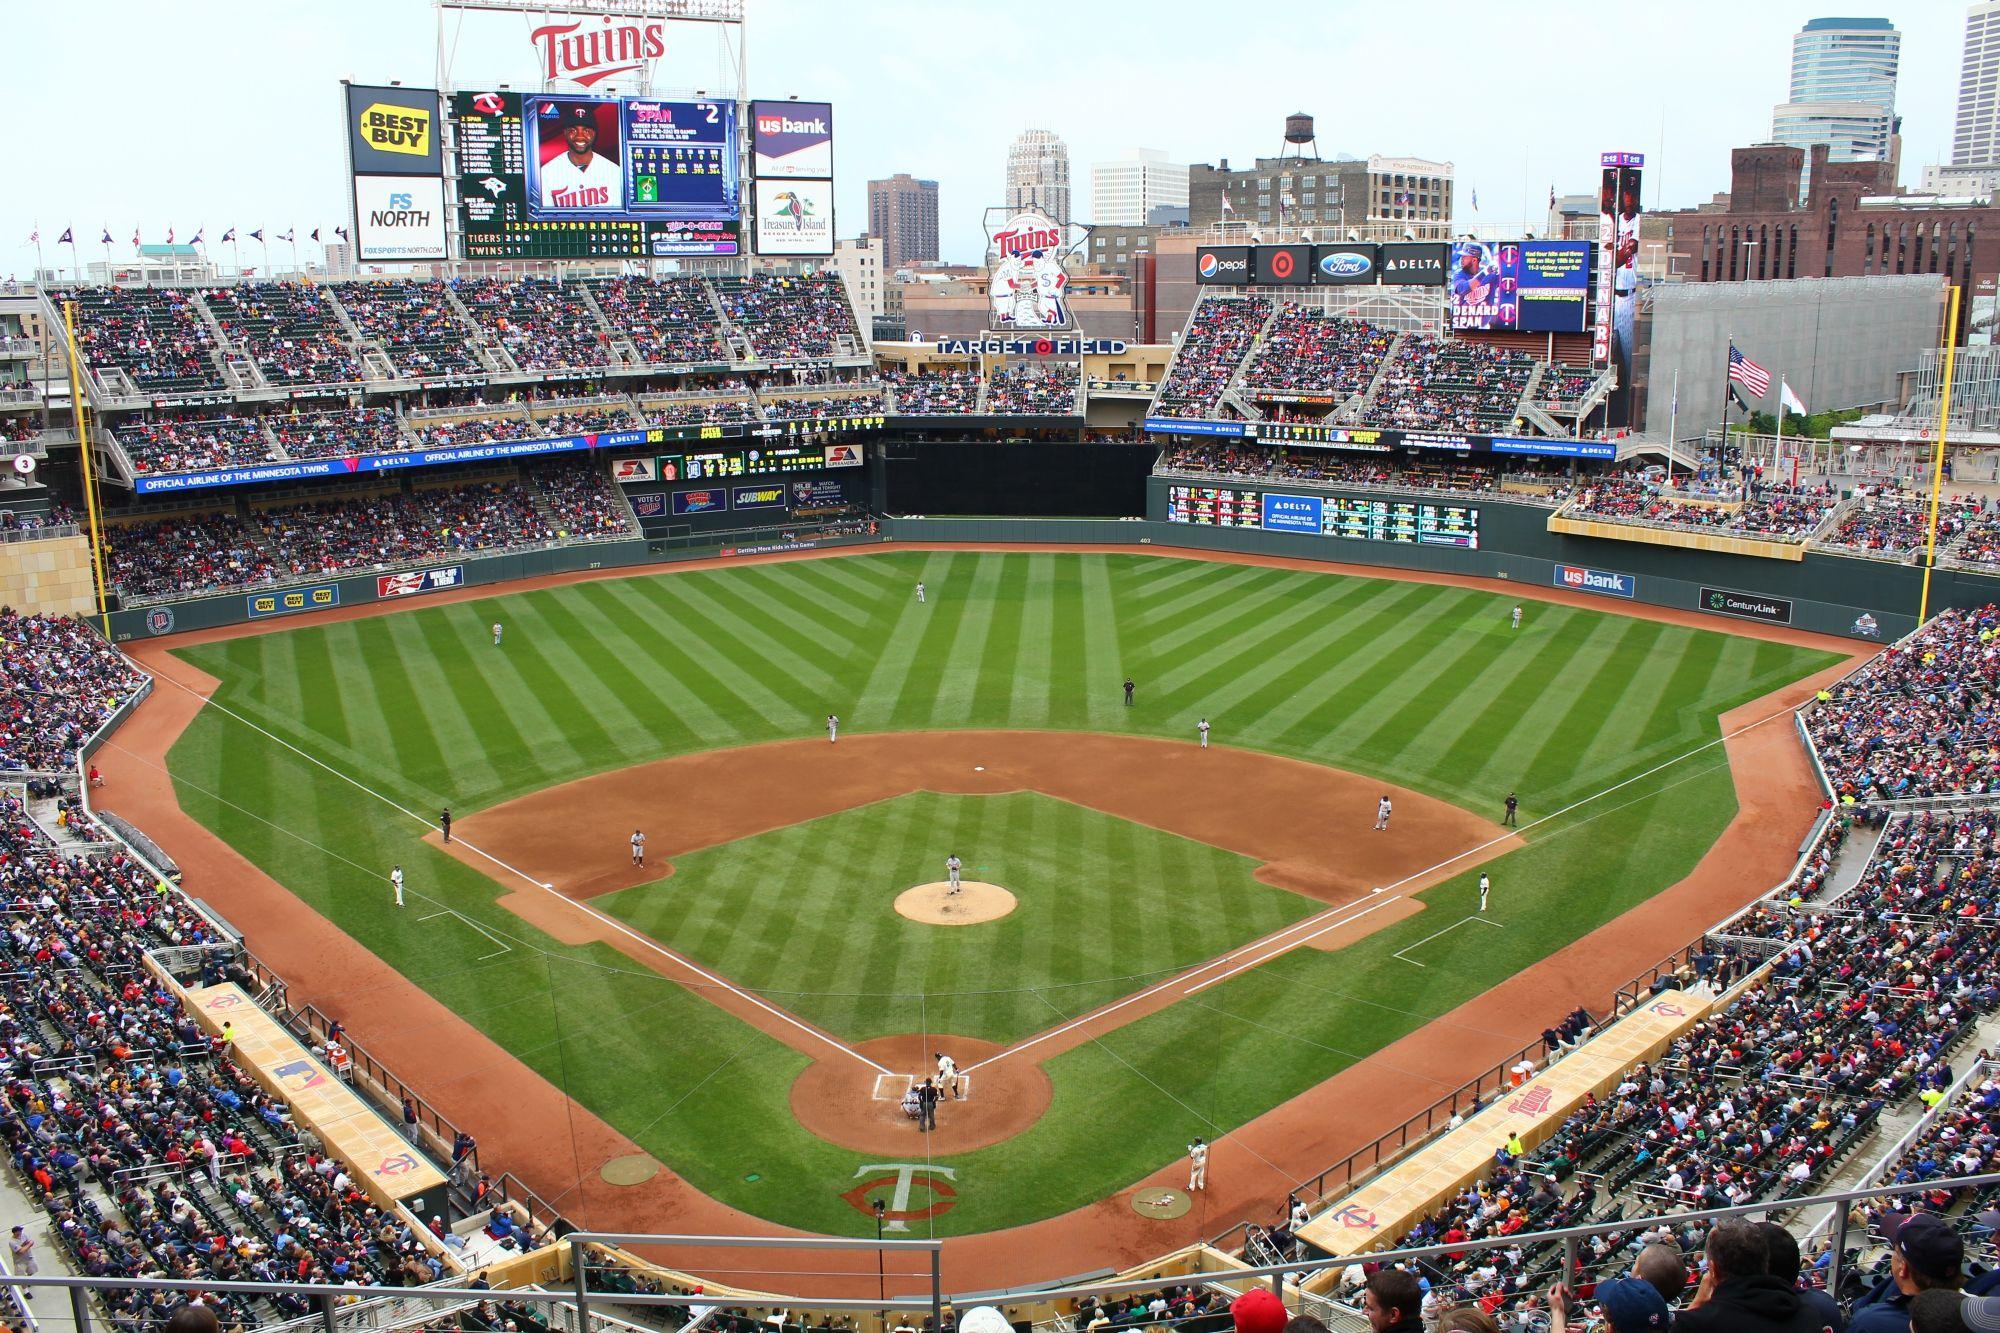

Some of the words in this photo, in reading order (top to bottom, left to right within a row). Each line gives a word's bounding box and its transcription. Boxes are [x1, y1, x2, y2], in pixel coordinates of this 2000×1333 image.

[531, 15, 665, 82] Twins
[637, 109, 671, 123] SPAN
[706, 104, 719, 123] 2
[369, 111, 427, 133] BEST
[759, 117, 827, 134] usbank
[372, 128, 423, 147] BUY
[389, 193, 413, 210] FS
[551, 184, 609, 207] Twins
[370, 210, 430, 227] NORTH
[762, 217, 795, 230] Treasure
[803, 217, 826, 230] Island
[514, 222, 521, 230] 2
[523, 222, 530, 230] 3
[532, 222, 539, 230] 4
[542, 222, 548, 230] 5
[560, 222, 567, 230] 7
[468, 234, 501, 243] TIGERS
[993, 226, 1060, 259] Twins
[469, 246, 503, 255] TWINS
[1218, 258, 1246, 271] pepsi
[1330, 255, 1361, 273] Ford
[1399, 259, 1441, 270] DELTA
[1452, 305, 1499, 316] DENARD
[1452, 316, 1482, 328] SPAN
[939, 340, 1032, 354] TARGET
[1057, 340, 1127, 354] FIELD
[293, 390, 319, 398] usbank
[616, 435, 640, 443] DELTA
[425, 452, 457, 462] OFFICIAL
[457, 449, 485, 459] AIRLINE
[485, 448, 496, 457] OF
[496, 446, 510, 455] THE
[510, 442, 550, 454] MINNESOTA
[551, 440, 574, 449] TWINS
[22, 459, 29, 469] 3
[382, 456, 410, 466] DELTA
[146, 479, 185, 490] OFFICIAL
[187, 476, 220, 486] AIRLINE
[221, 474, 233, 483] OF
[234, 472, 252, 481] THE
[252, 468, 301, 480] MINNESOTA
[302, 464, 330, 474] TWINS
[737, 489, 782, 504] SUBWAY
[1283, 502, 1312, 511] DELTA
[737, 546, 757, 554] Getting
[429, 568, 458, 580] WALK-OFF
[1563, 569, 1624, 591] usbank
[386, 576, 422, 590] Budweiser
[440, 576, 455, 587] HERO
[1726, 598, 1777, 615] CenturyLink
[117, 633, 131, 641] 339
[1508, 1085, 1552, 1118] Twins
